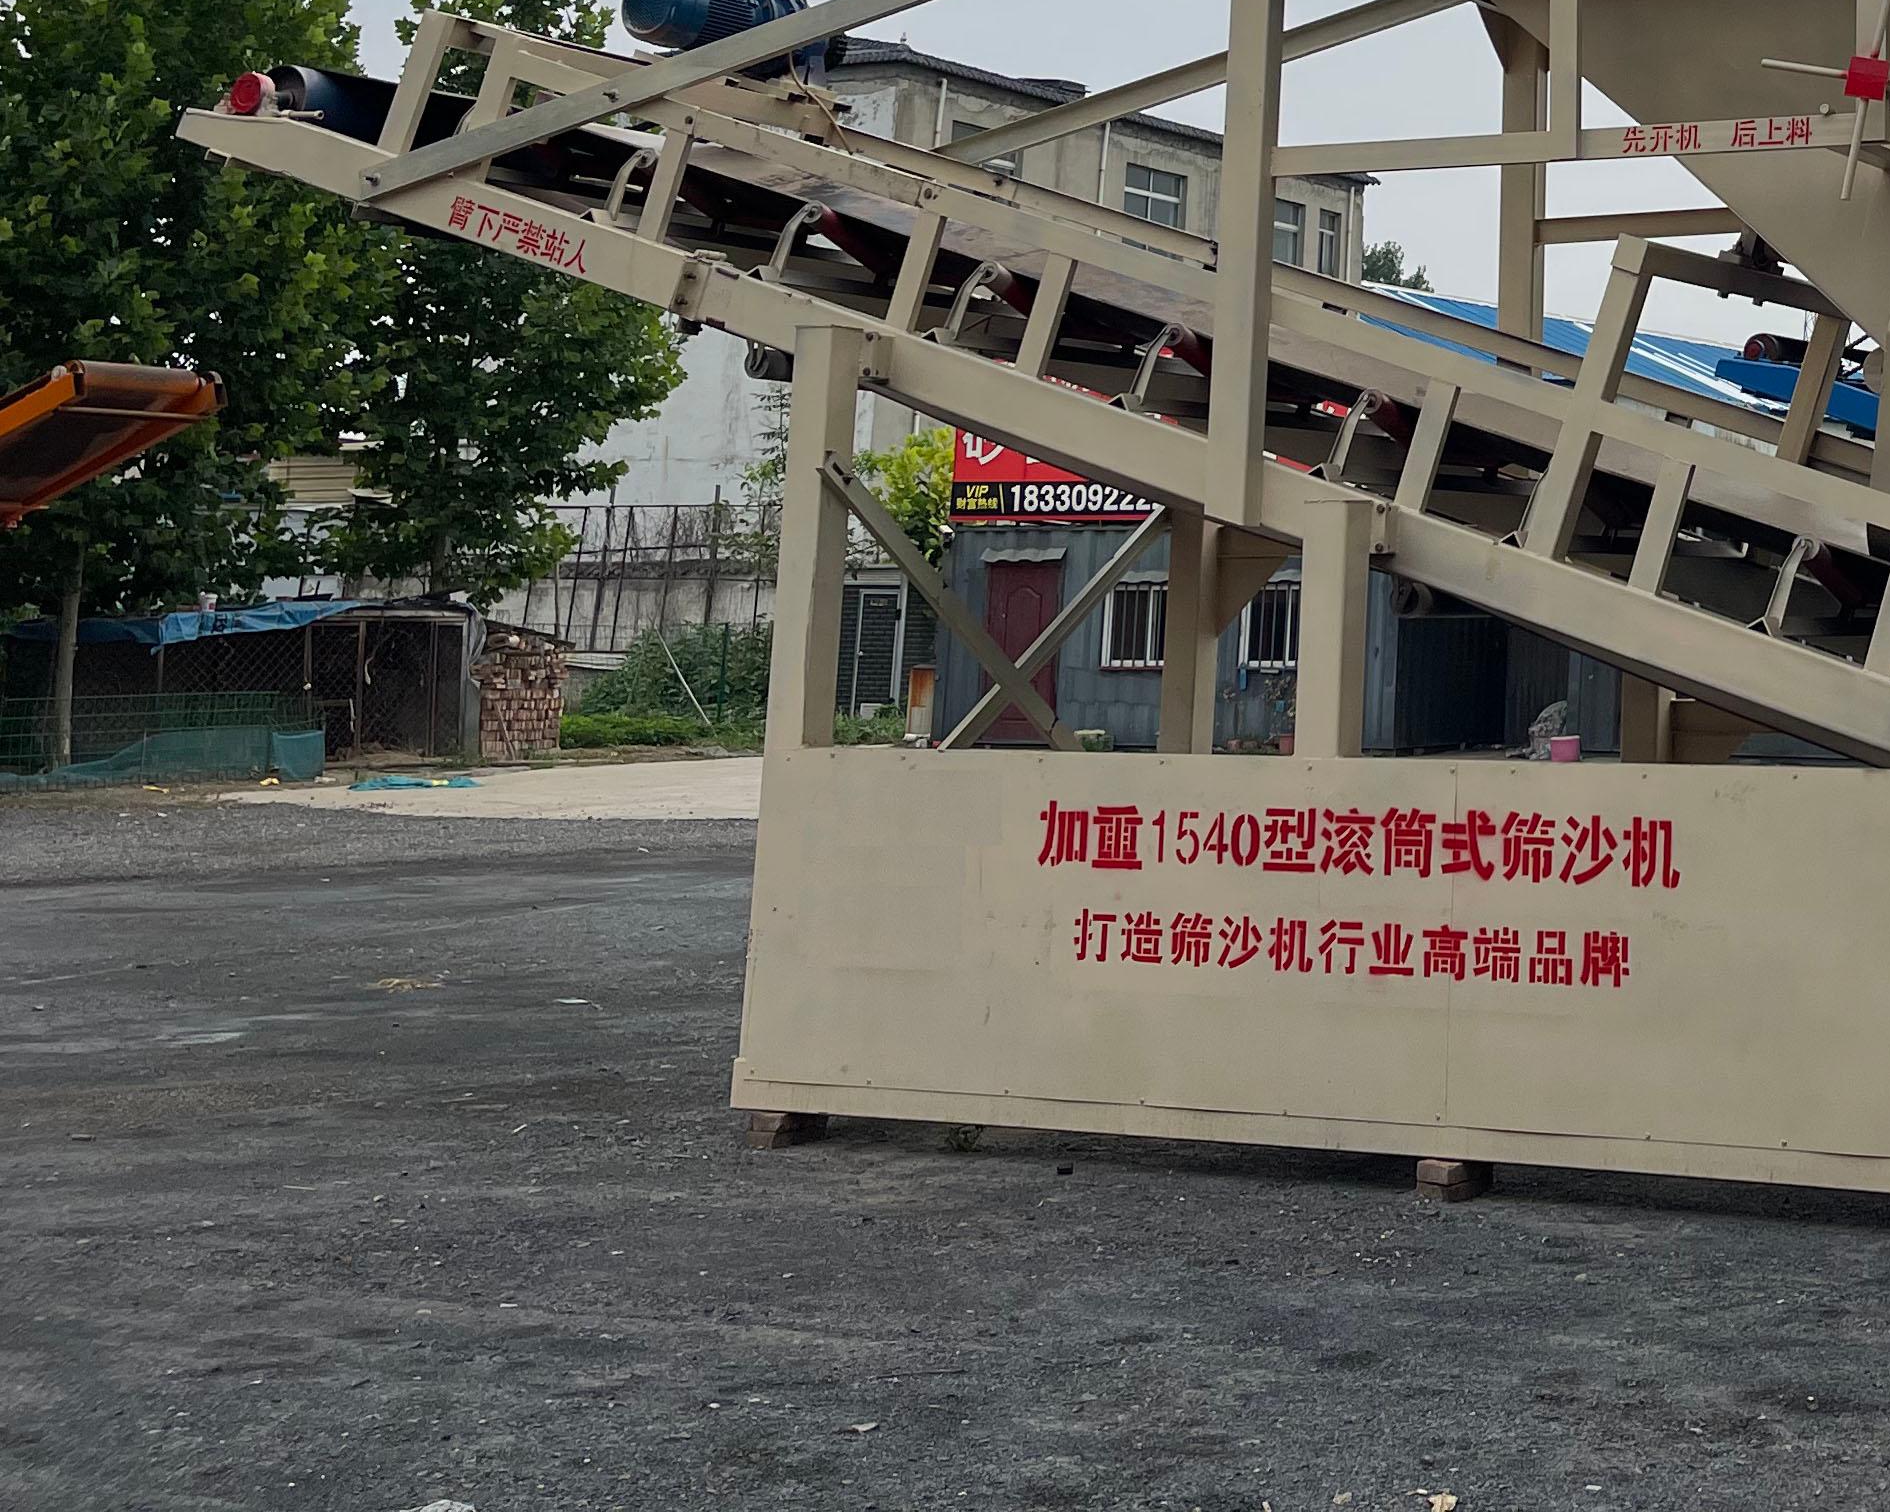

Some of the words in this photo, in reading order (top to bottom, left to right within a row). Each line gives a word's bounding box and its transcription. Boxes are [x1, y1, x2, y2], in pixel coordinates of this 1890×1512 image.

[1622, 123, 1701, 154] 先开机
[1730, 116, 1812, 147] 后上料
[448, 195, 586, 274] 臂下严禁站人
[966, 484, 989, 498] VIP
[1010, 484, 1162, 512] 18330922
[1037, 799, 1681, 888] 加重1540型滚筒式筛沙机
[1074, 908, 1632, 987] 打造筛沙机行业高端品牌
